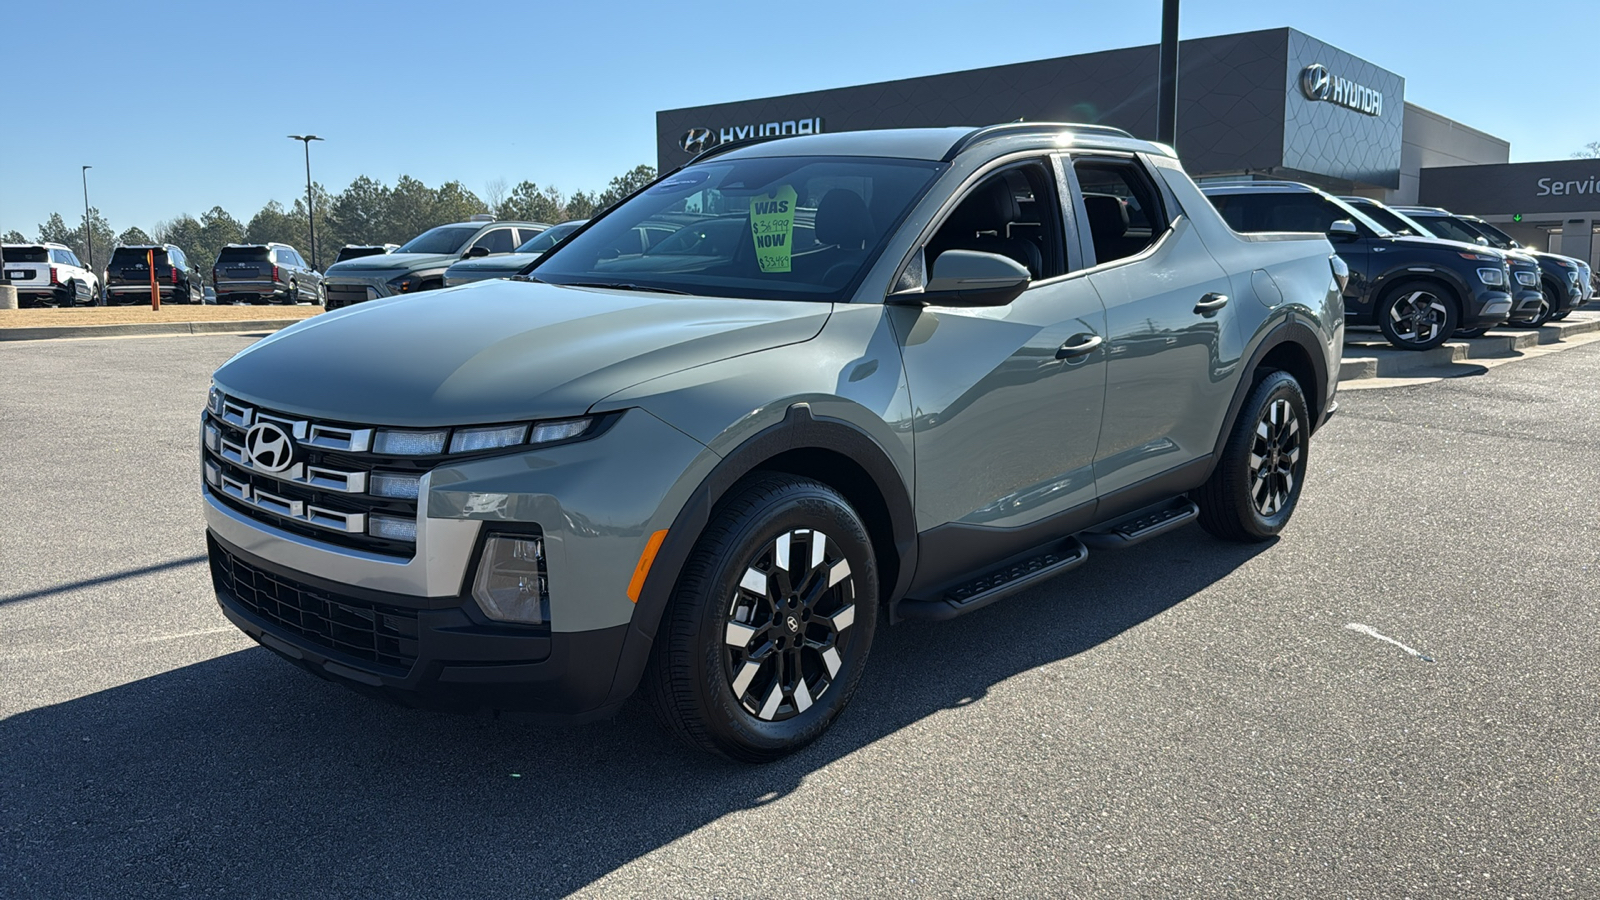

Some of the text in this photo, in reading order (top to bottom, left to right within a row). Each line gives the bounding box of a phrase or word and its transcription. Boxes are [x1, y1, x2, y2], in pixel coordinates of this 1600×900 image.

[1333, 75, 1383, 117] HYUNDAI
[754, 200, 789, 215] WAS
[756, 233, 787, 249] NOW
